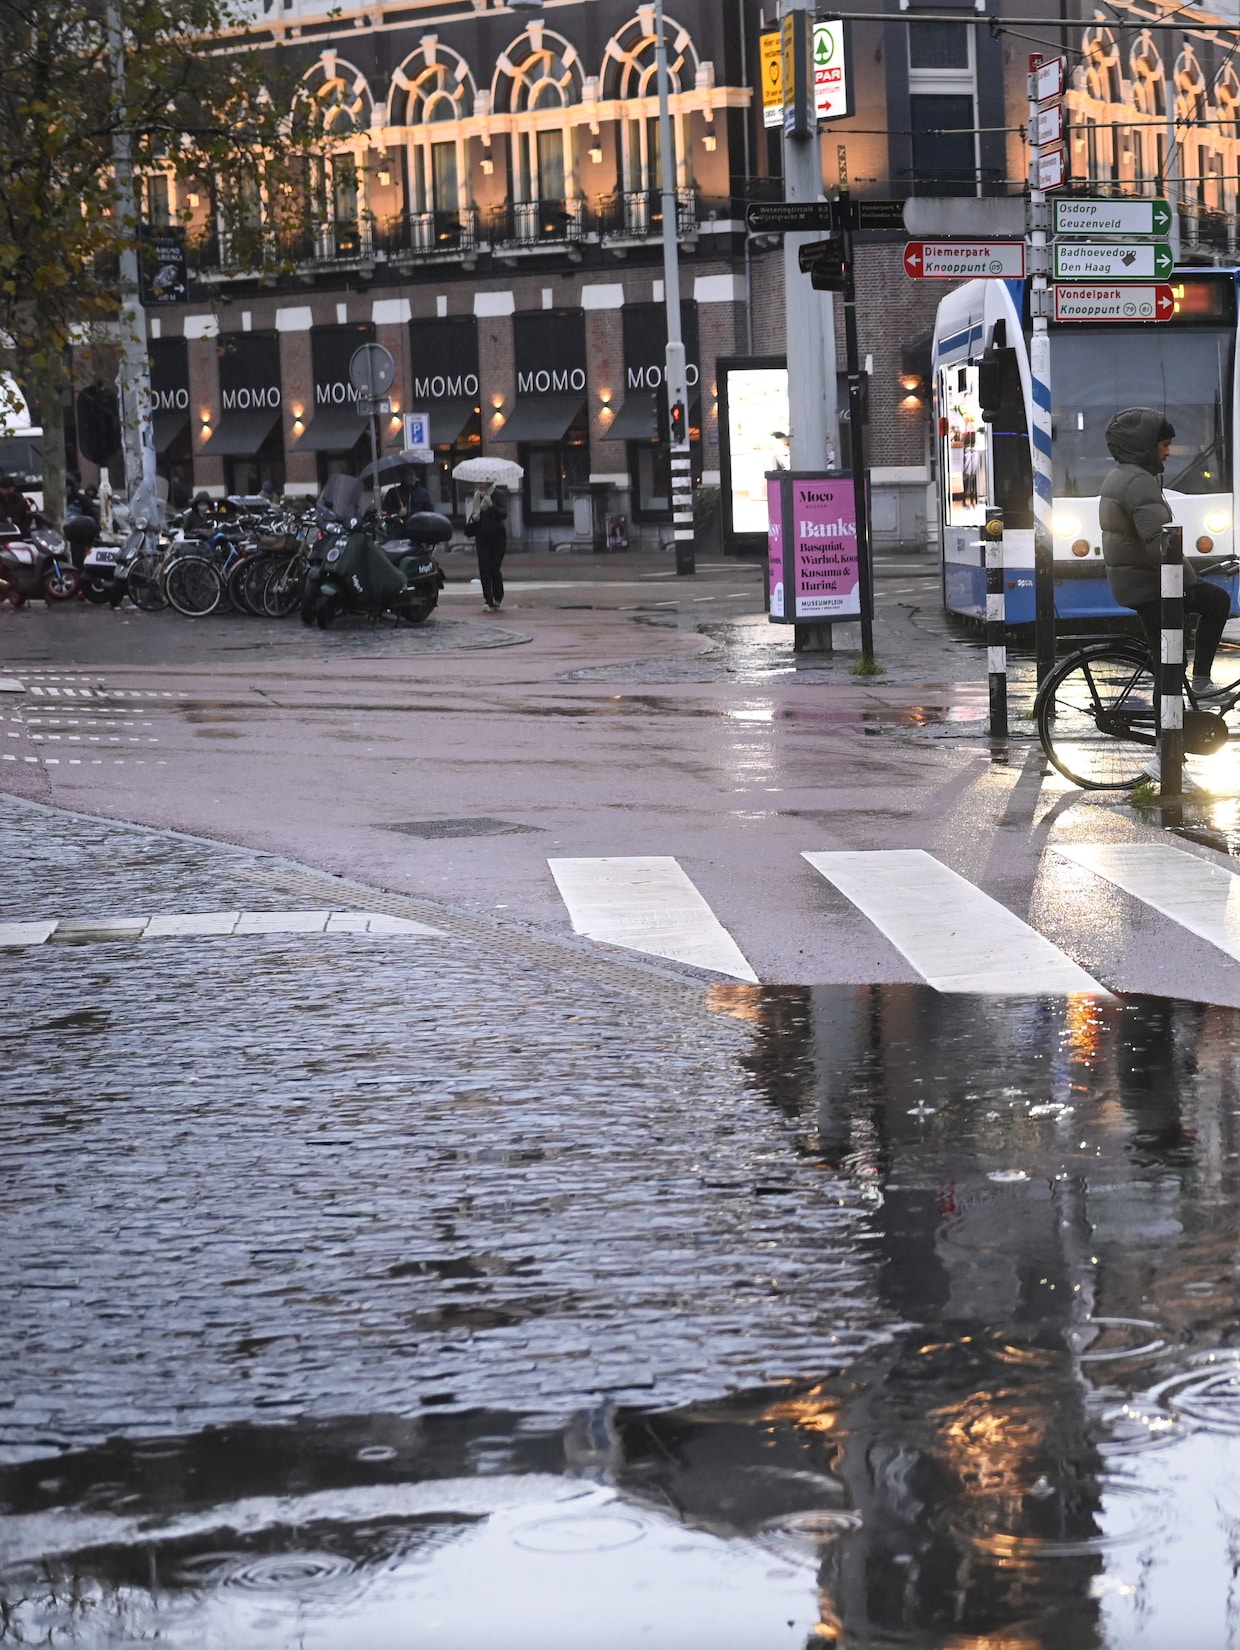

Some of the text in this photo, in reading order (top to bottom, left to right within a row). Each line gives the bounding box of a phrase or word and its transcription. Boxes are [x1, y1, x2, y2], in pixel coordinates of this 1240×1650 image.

[815, 69, 841, 82] PAR
[1059, 204, 1097, 215] Osdorp
[1059, 219, 1121, 228] Geuzenveld
[925, 247, 990, 258] Diemerpark
[1060, 248, 1137, 258] Badhoevedorp
[925, 262, 987, 273] Knooppunt
[1060, 263, 1111, 274] Den Haag
[1059, 289, 1121, 301] Vondelpark
[1060, 305, 1121, 315] Knooppunt
[517, 368, 586, 393] MOMO
[627, 363, 699, 389] MOO
[414, 374, 479, 398] MOMO
[222, 386, 281, 409] MOMO
[316, 382, 362, 404] MOM
[150, 388, 189, 411] OMO
[800, 491, 833, 502] Moco
[800, 517, 857, 540] Banks
[800, 541, 844, 552] Basquiat,
[801, 554, 840, 564] Warhol,
[801, 567, 851, 578] Kusama &
[801, 580, 837, 592] Haring
[801, 599, 844, 607] MUSEUMPLEIN
